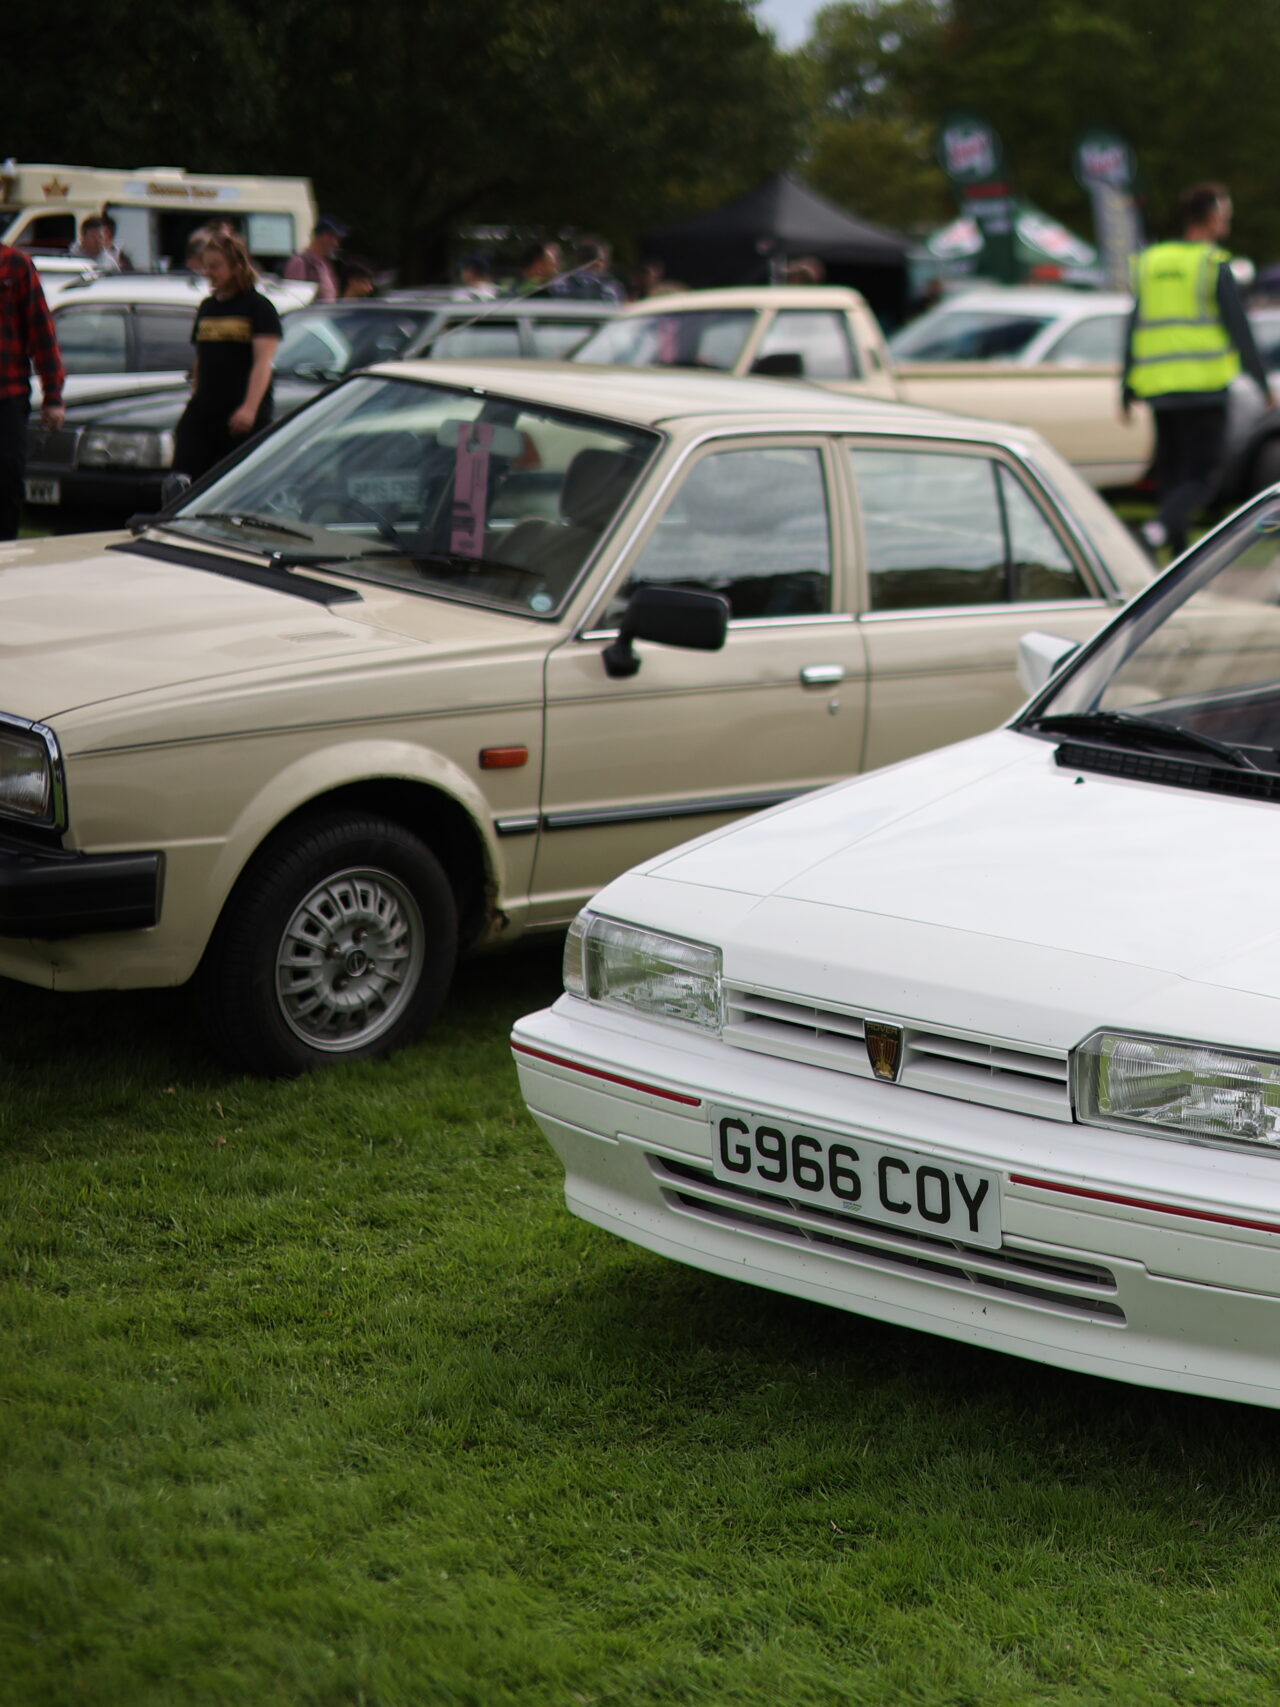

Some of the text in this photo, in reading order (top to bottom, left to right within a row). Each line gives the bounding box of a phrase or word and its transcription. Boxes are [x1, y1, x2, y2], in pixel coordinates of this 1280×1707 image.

[866, 1022, 898, 1035] ROVER
[718, 1116, 989, 1233] G966 COY
